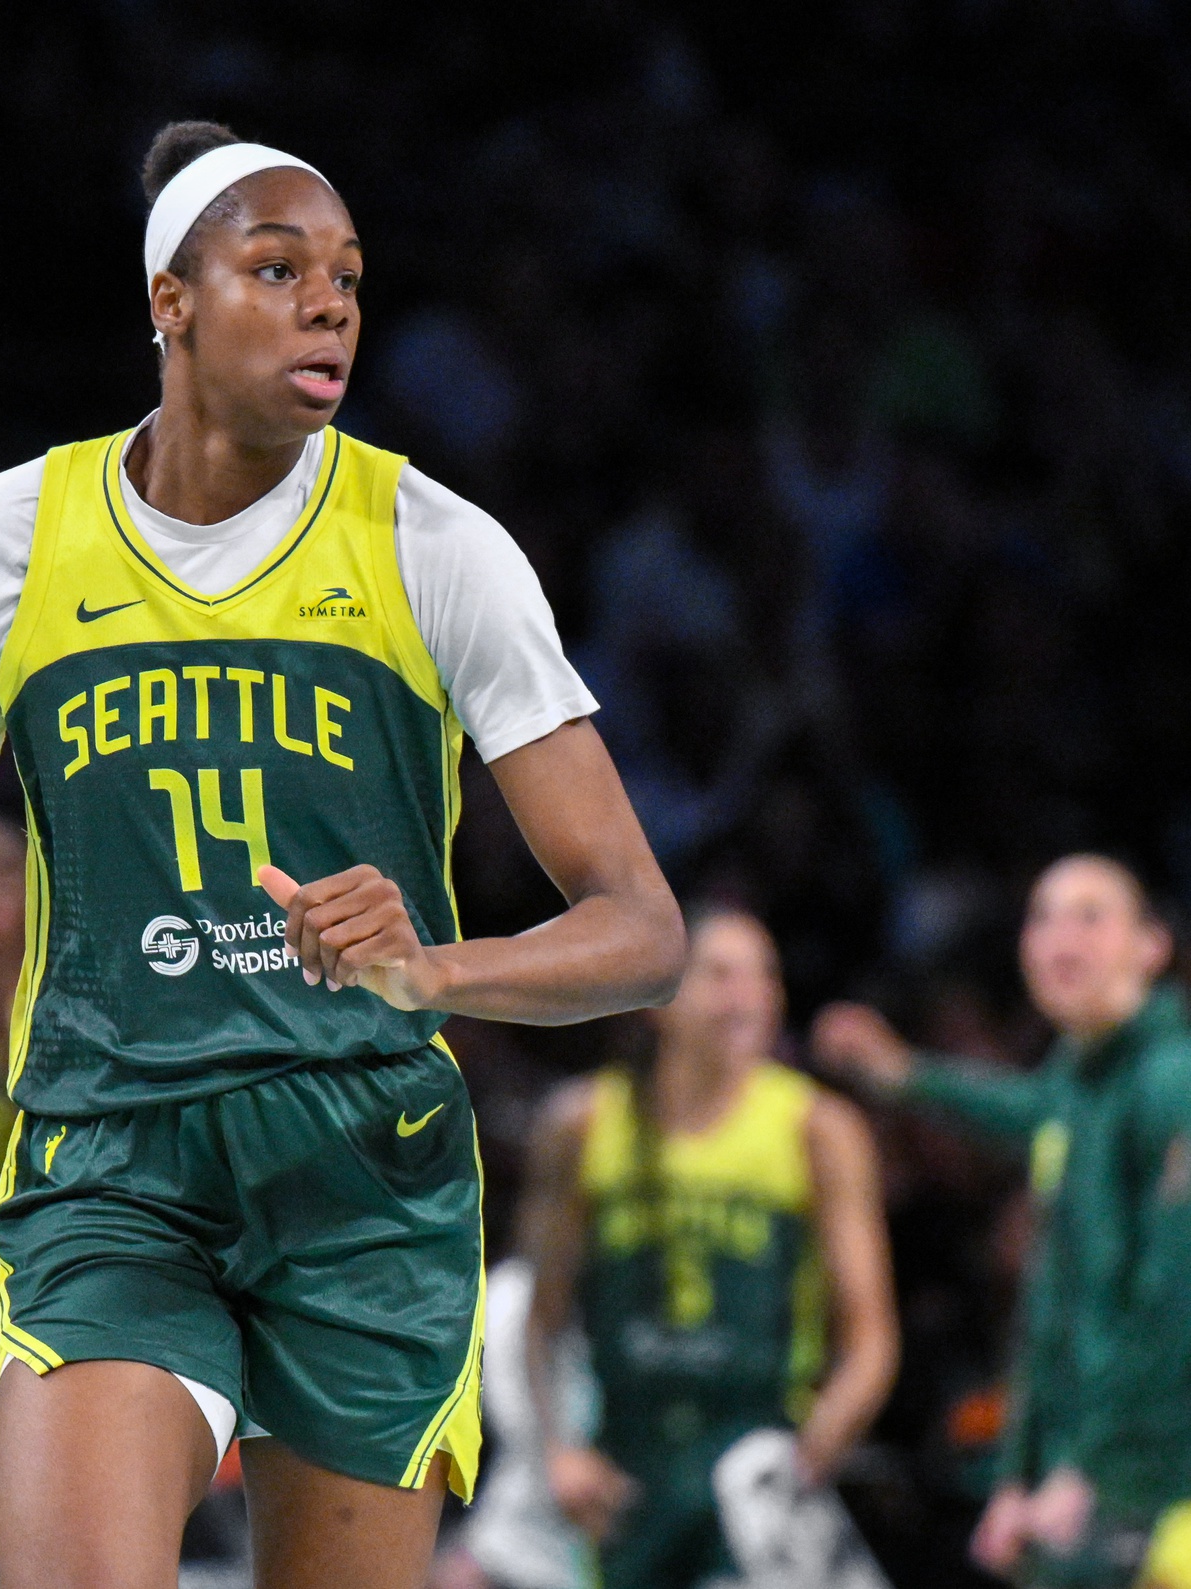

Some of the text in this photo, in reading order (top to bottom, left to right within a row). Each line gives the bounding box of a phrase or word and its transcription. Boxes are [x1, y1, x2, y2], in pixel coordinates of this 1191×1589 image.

[298, 606, 366, 617] SYMETRA
[58, 667, 354, 780] SEATTLE
[148, 768, 271, 892] 14
[196, 912, 288, 943] Provide
